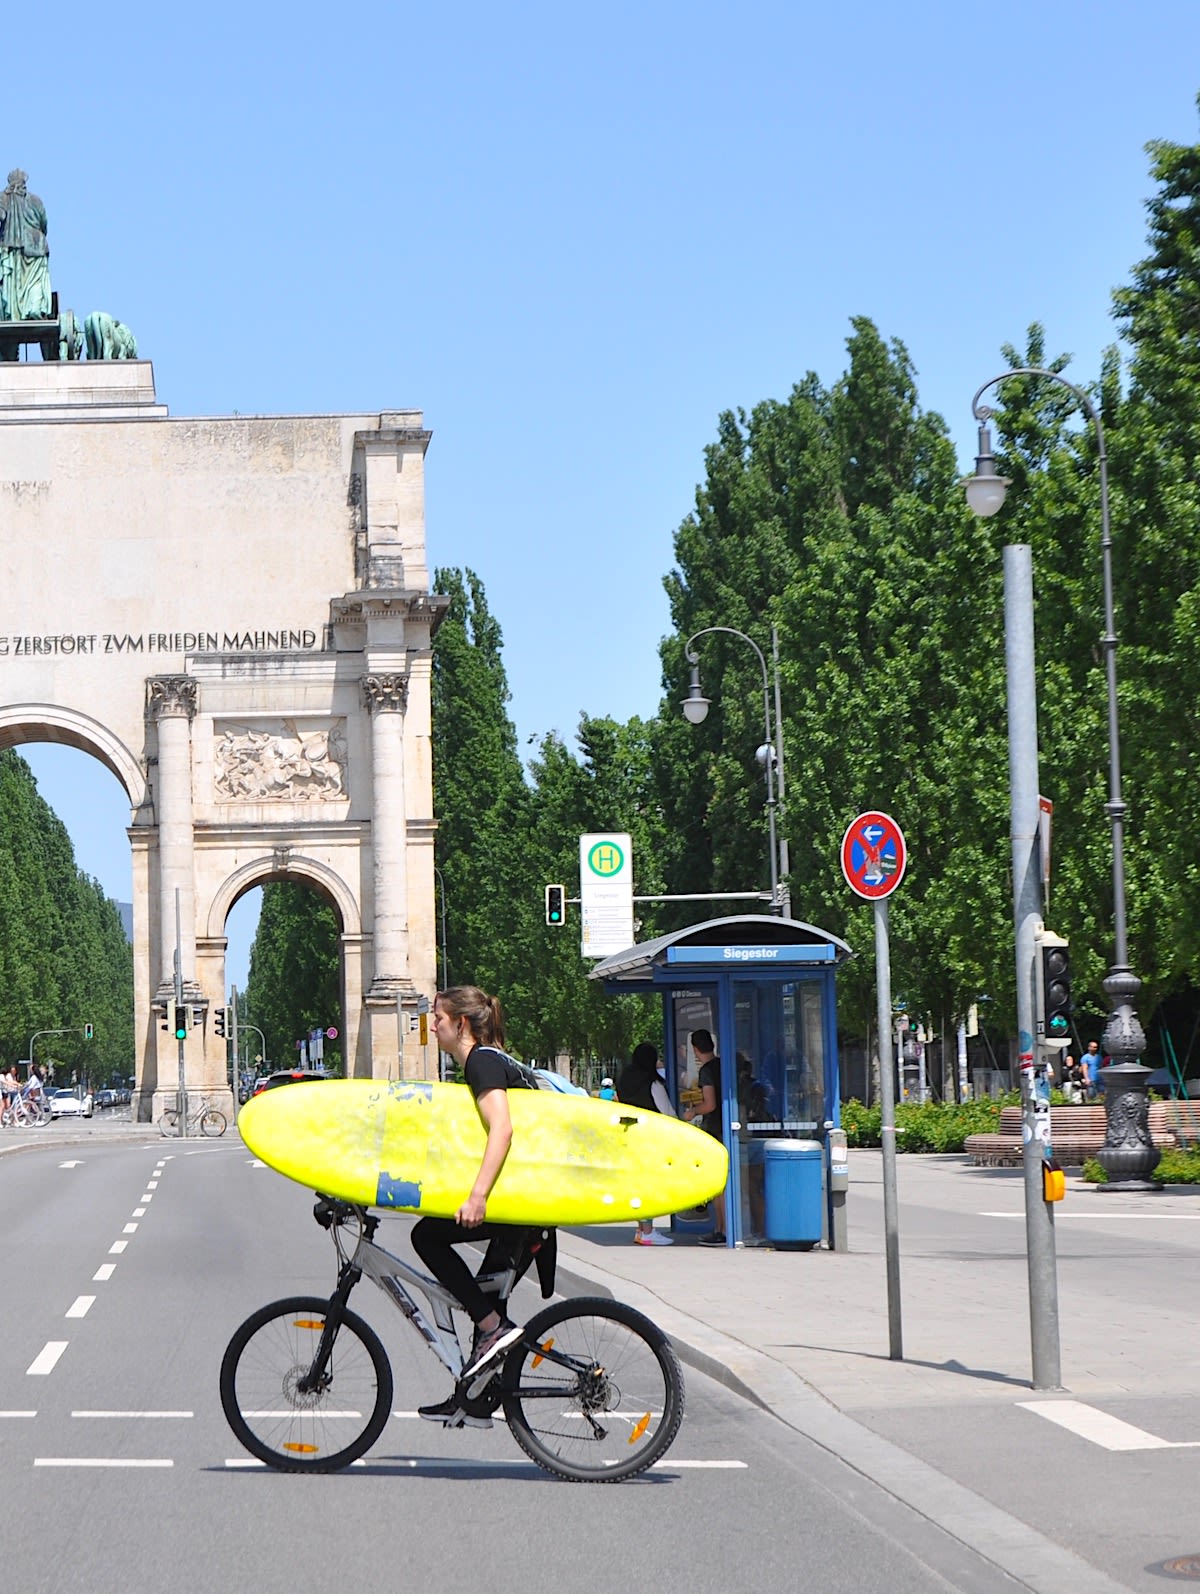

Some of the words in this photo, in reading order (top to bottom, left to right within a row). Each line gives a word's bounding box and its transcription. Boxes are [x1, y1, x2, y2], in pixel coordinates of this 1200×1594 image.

[13, 633, 97, 656] ZERSTÖRT
[103, 633, 144, 654] ZVM
[149, 632, 218, 652] FRIEDEN
[223, 629, 316, 650] MAHNEND
[598, 849, 613, 870] H
[723, 947, 778, 960] Siegestor
